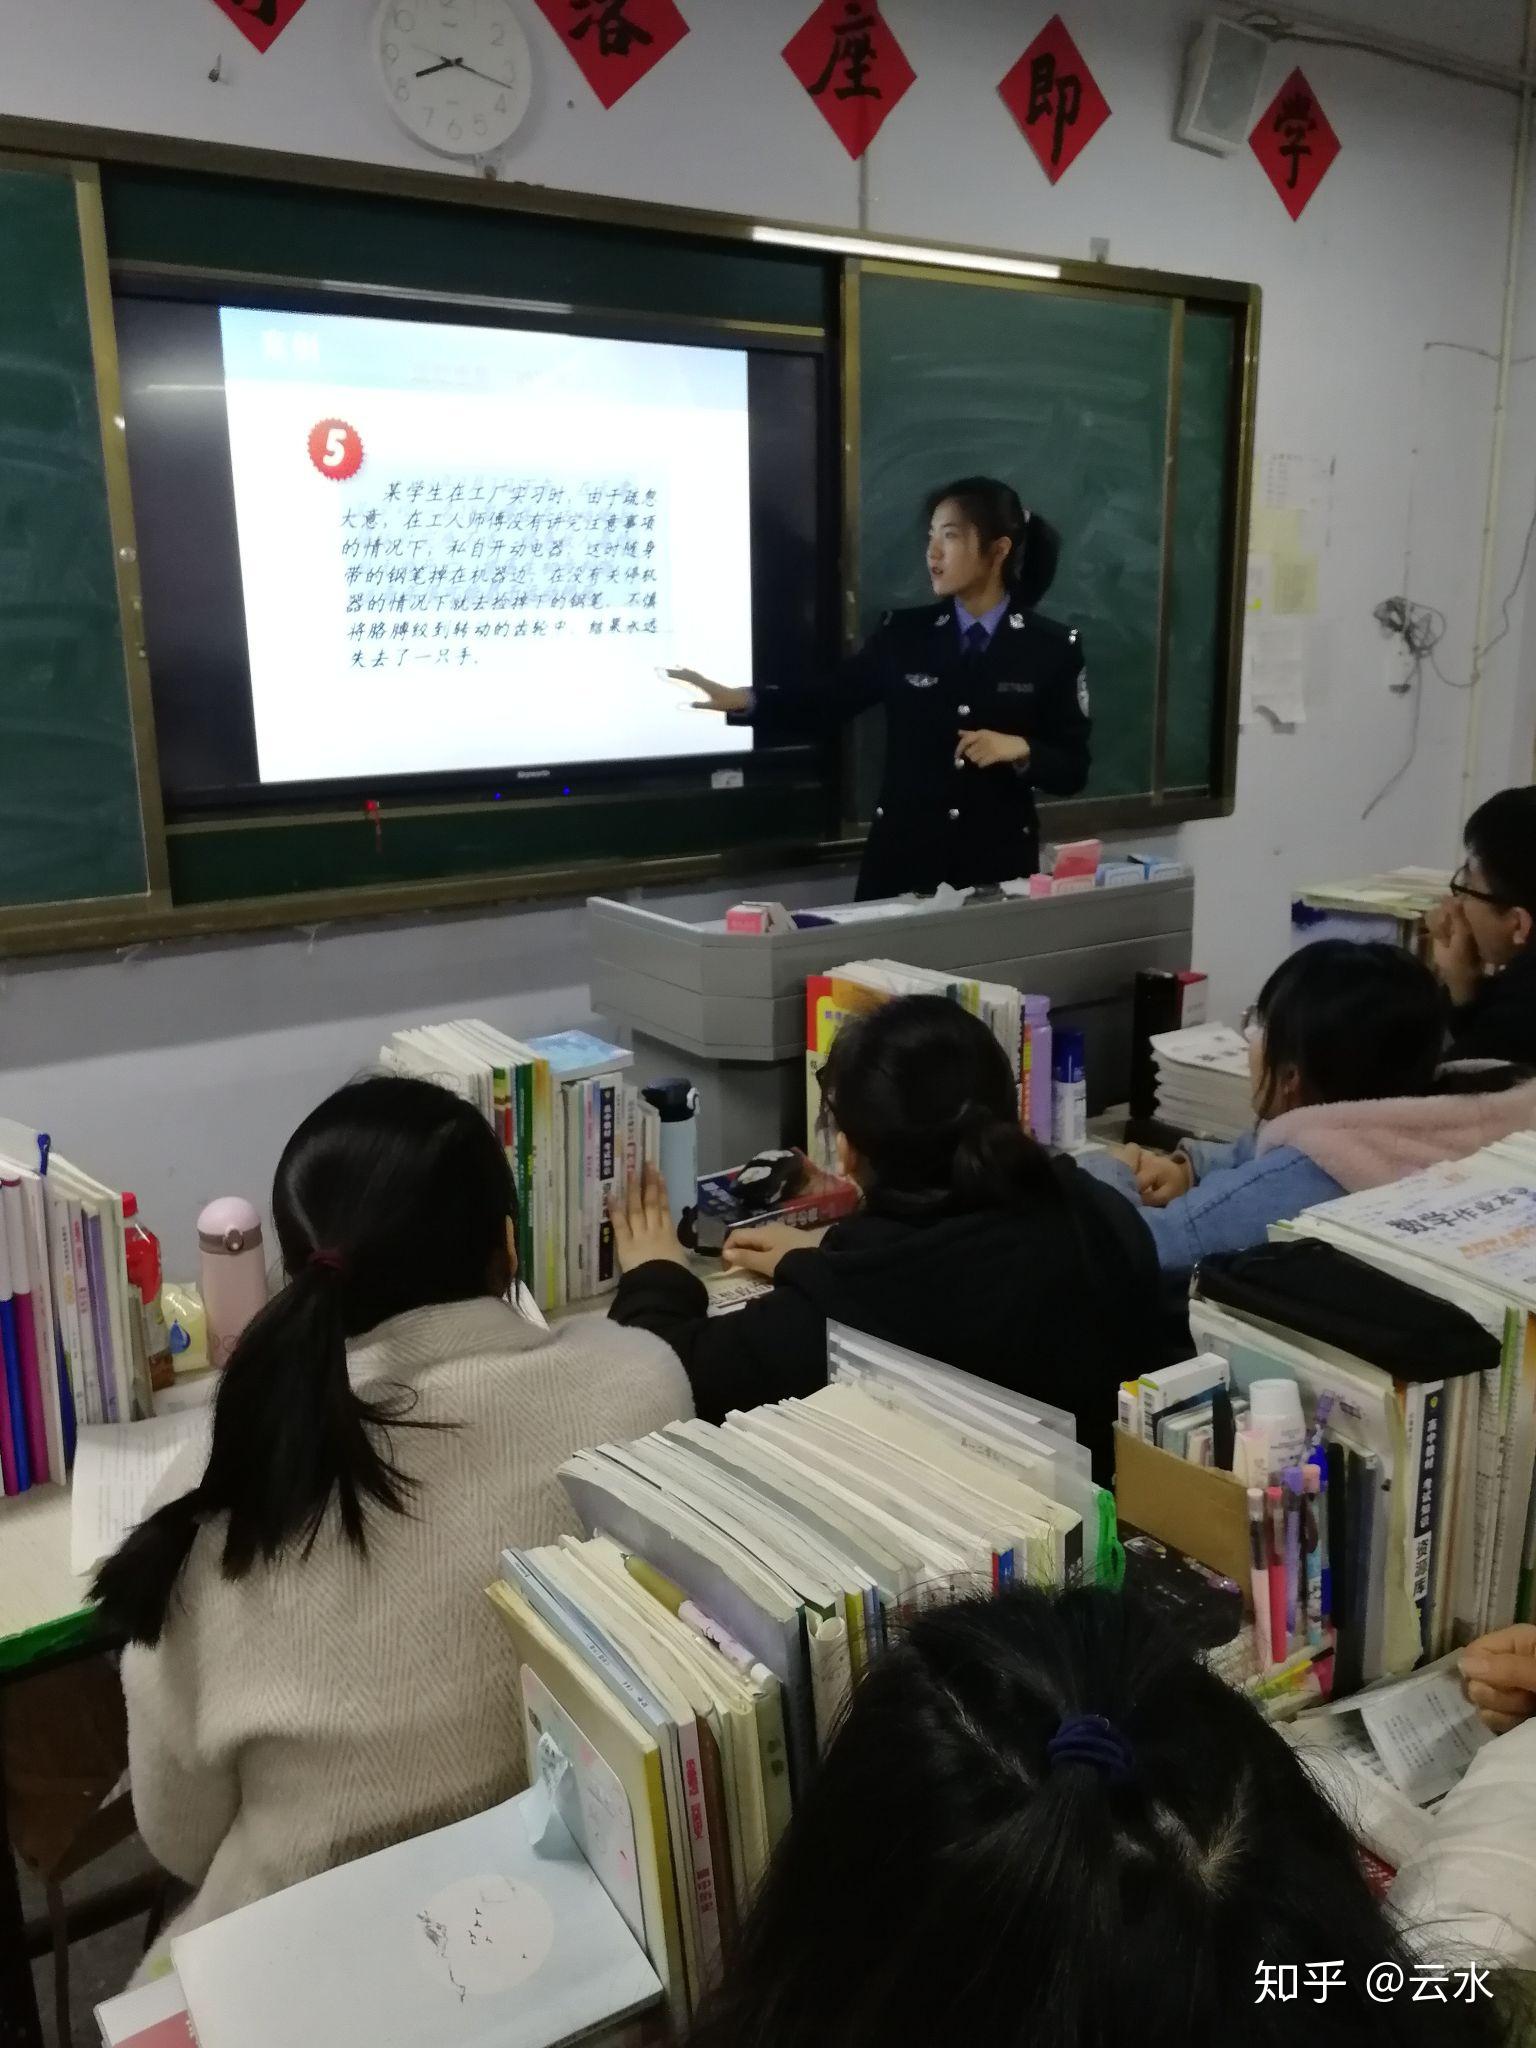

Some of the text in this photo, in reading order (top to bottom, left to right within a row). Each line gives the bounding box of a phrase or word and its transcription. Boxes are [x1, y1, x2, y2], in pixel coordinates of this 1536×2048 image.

[807, 2, 883, 101] 座
[1025, 51, 1082, 165] 即
[322, 428, 347, 467] 5
